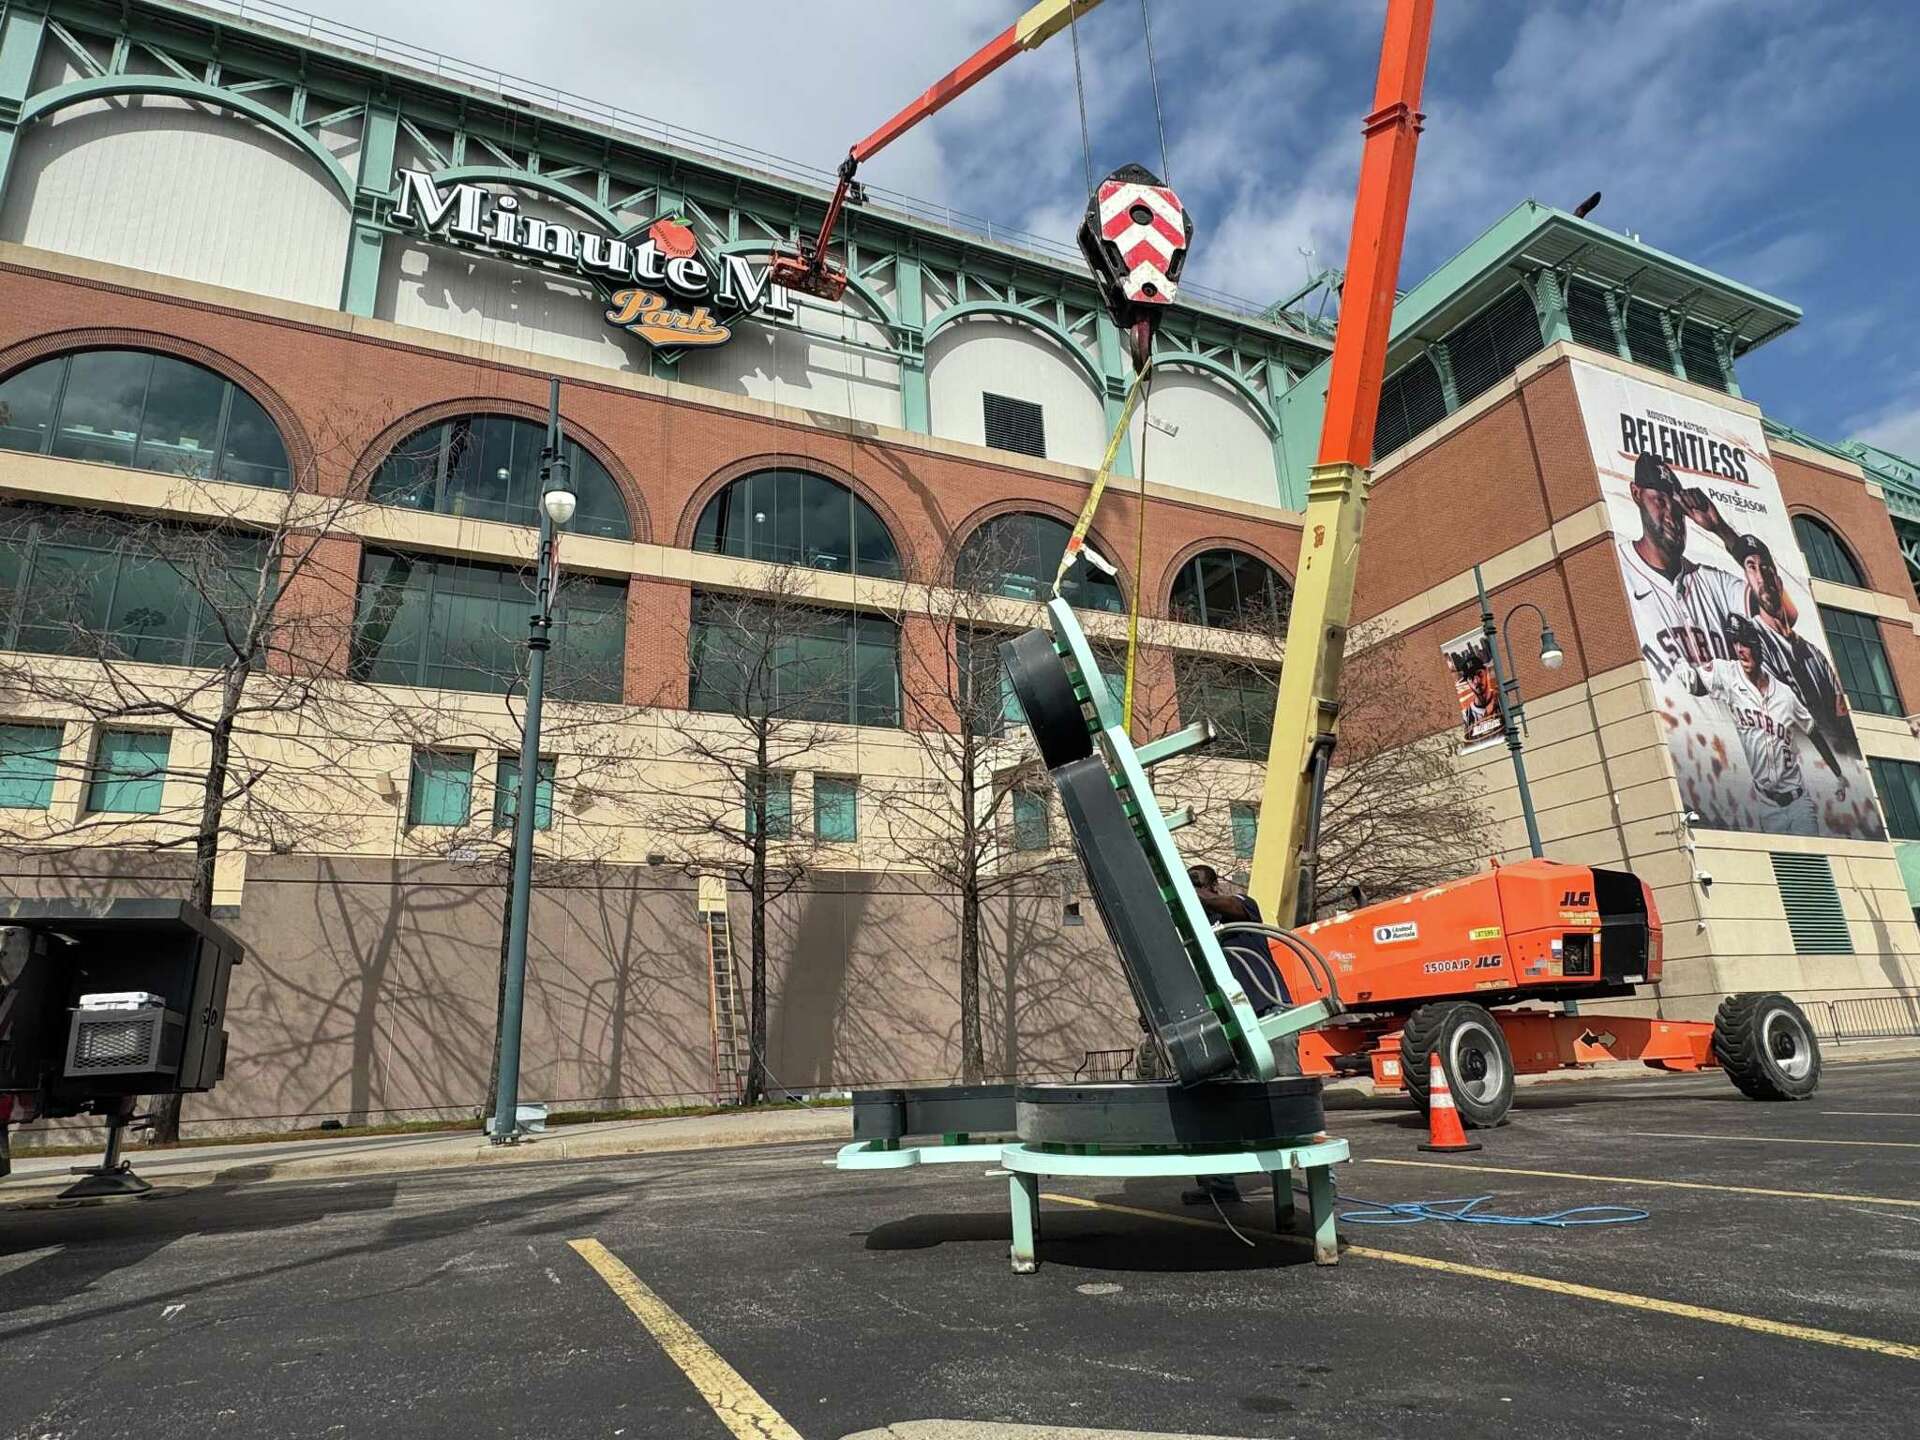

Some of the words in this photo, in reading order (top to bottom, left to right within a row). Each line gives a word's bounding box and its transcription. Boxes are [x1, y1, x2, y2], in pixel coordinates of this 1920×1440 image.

[387, 167, 709, 296] Minute
[608, 288, 730, 345] Park
[1620, 412, 1750, 484] RELENTLESS
[1708, 488, 1767, 514] POSTSEASON
[1737, 708, 1792, 746] ASTROS
[1560, 891, 1591, 907] JLG
[1424, 960, 1470, 974] 1500AJP
[1475, 955, 1502, 969] JLG
